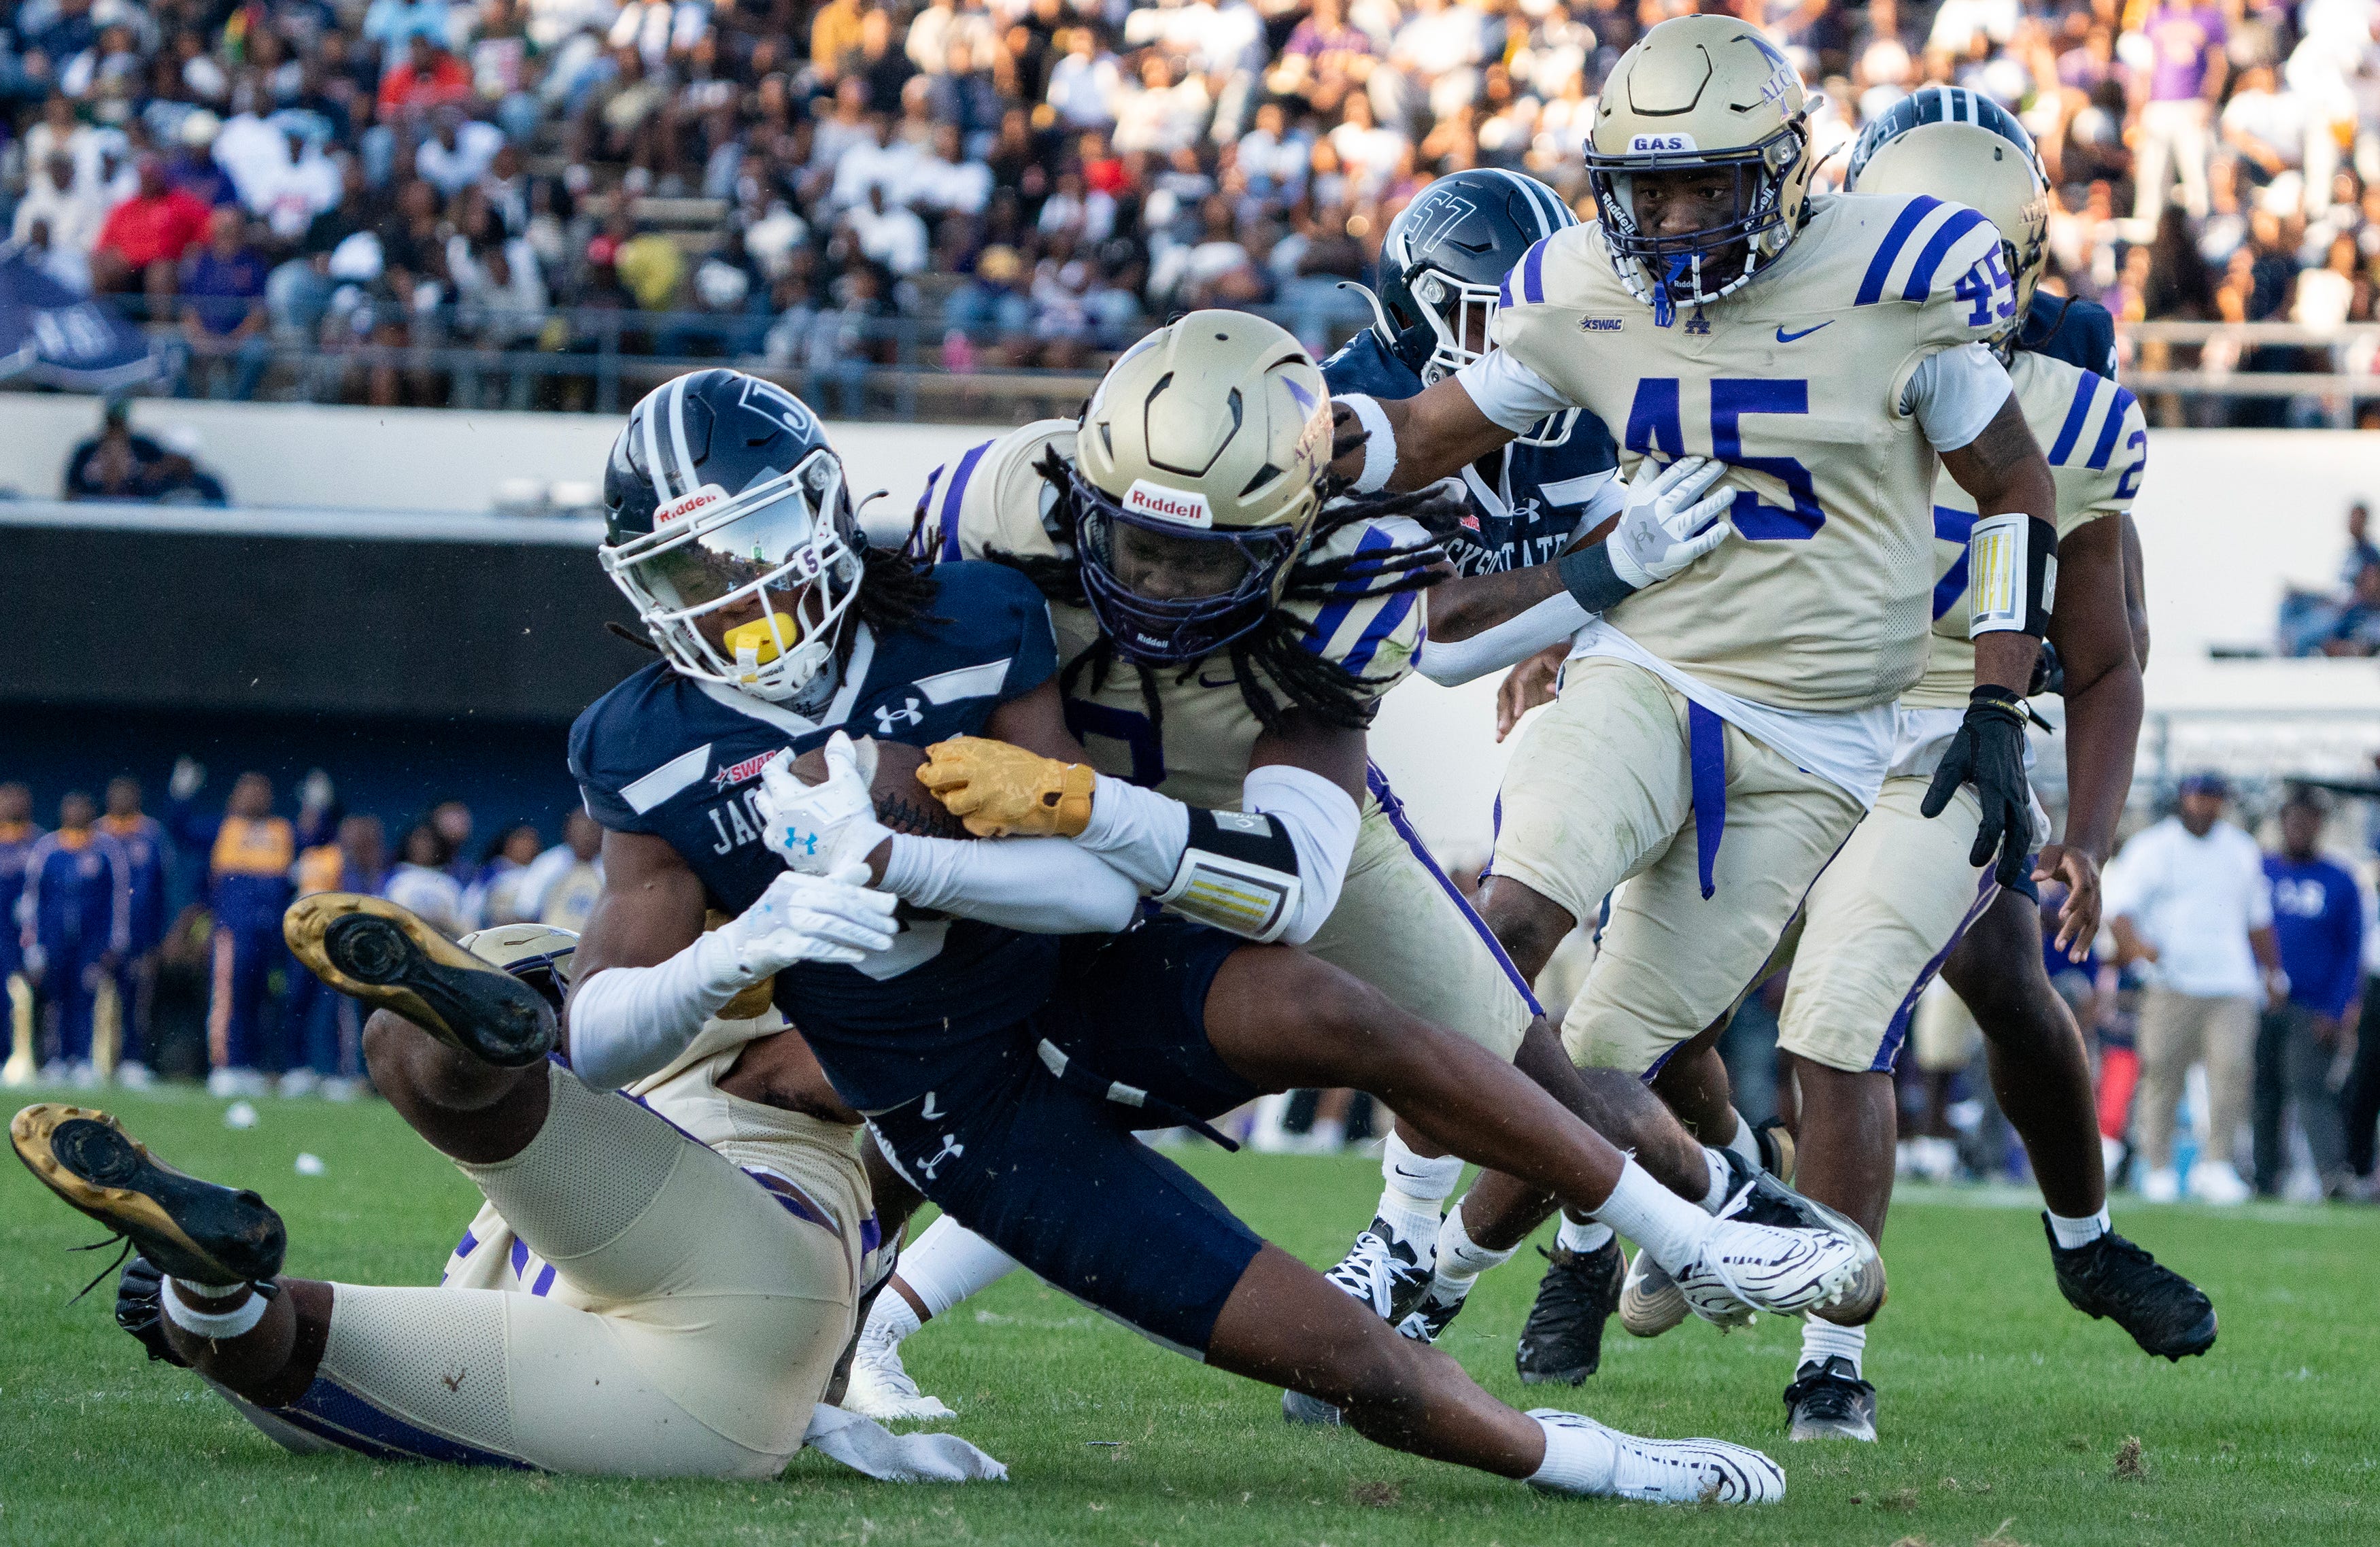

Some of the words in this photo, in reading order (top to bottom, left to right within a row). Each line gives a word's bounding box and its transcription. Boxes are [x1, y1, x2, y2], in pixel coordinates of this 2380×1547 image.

[1635, 138, 1685, 150] G.A.S.
[1401, 190, 1477, 253] 57
[1603, 192, 1636, 234] Riddell
[1955, 241, 2016, 326] 45
[1593, 319, 1621, 330] SWAC
[750, 381, 809, 432] J
[1625, 377, 1826, 541] 45
[2114, 430, 2147, 500] 2
[661, 495, 717, 522] Rddel
[1132, 490, 1202, 519] Riddell
[802, 547, 819, 573] 5
[1137, 632, 1169, 648] Riddell
